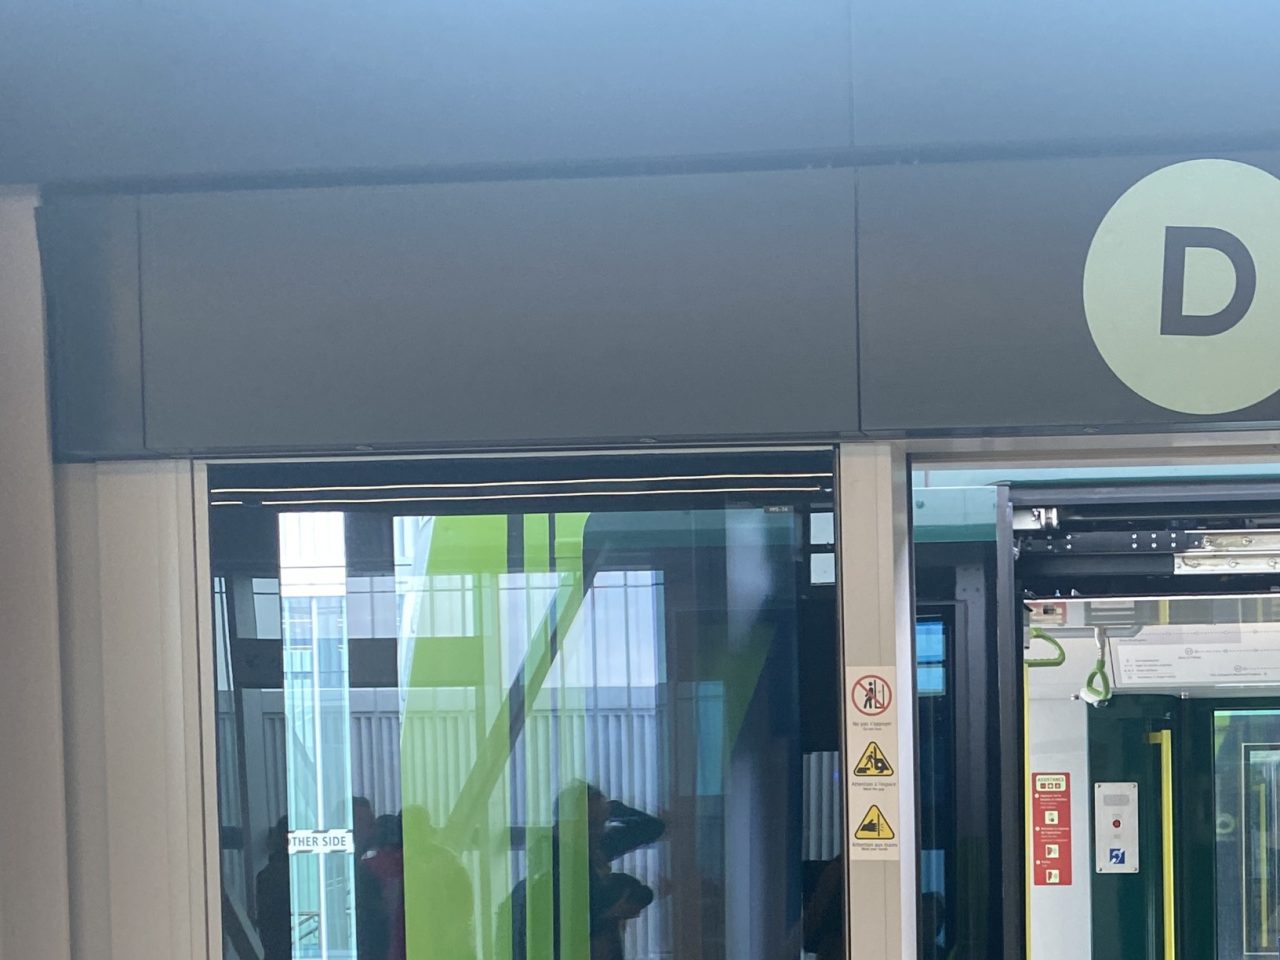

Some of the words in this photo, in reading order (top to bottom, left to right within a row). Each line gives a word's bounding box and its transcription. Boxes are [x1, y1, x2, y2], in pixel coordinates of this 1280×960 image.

[1160, 226, 1257, 336] D
[287, 836, 319, 847] THER
[322, 836, 347, 847] SIDE
